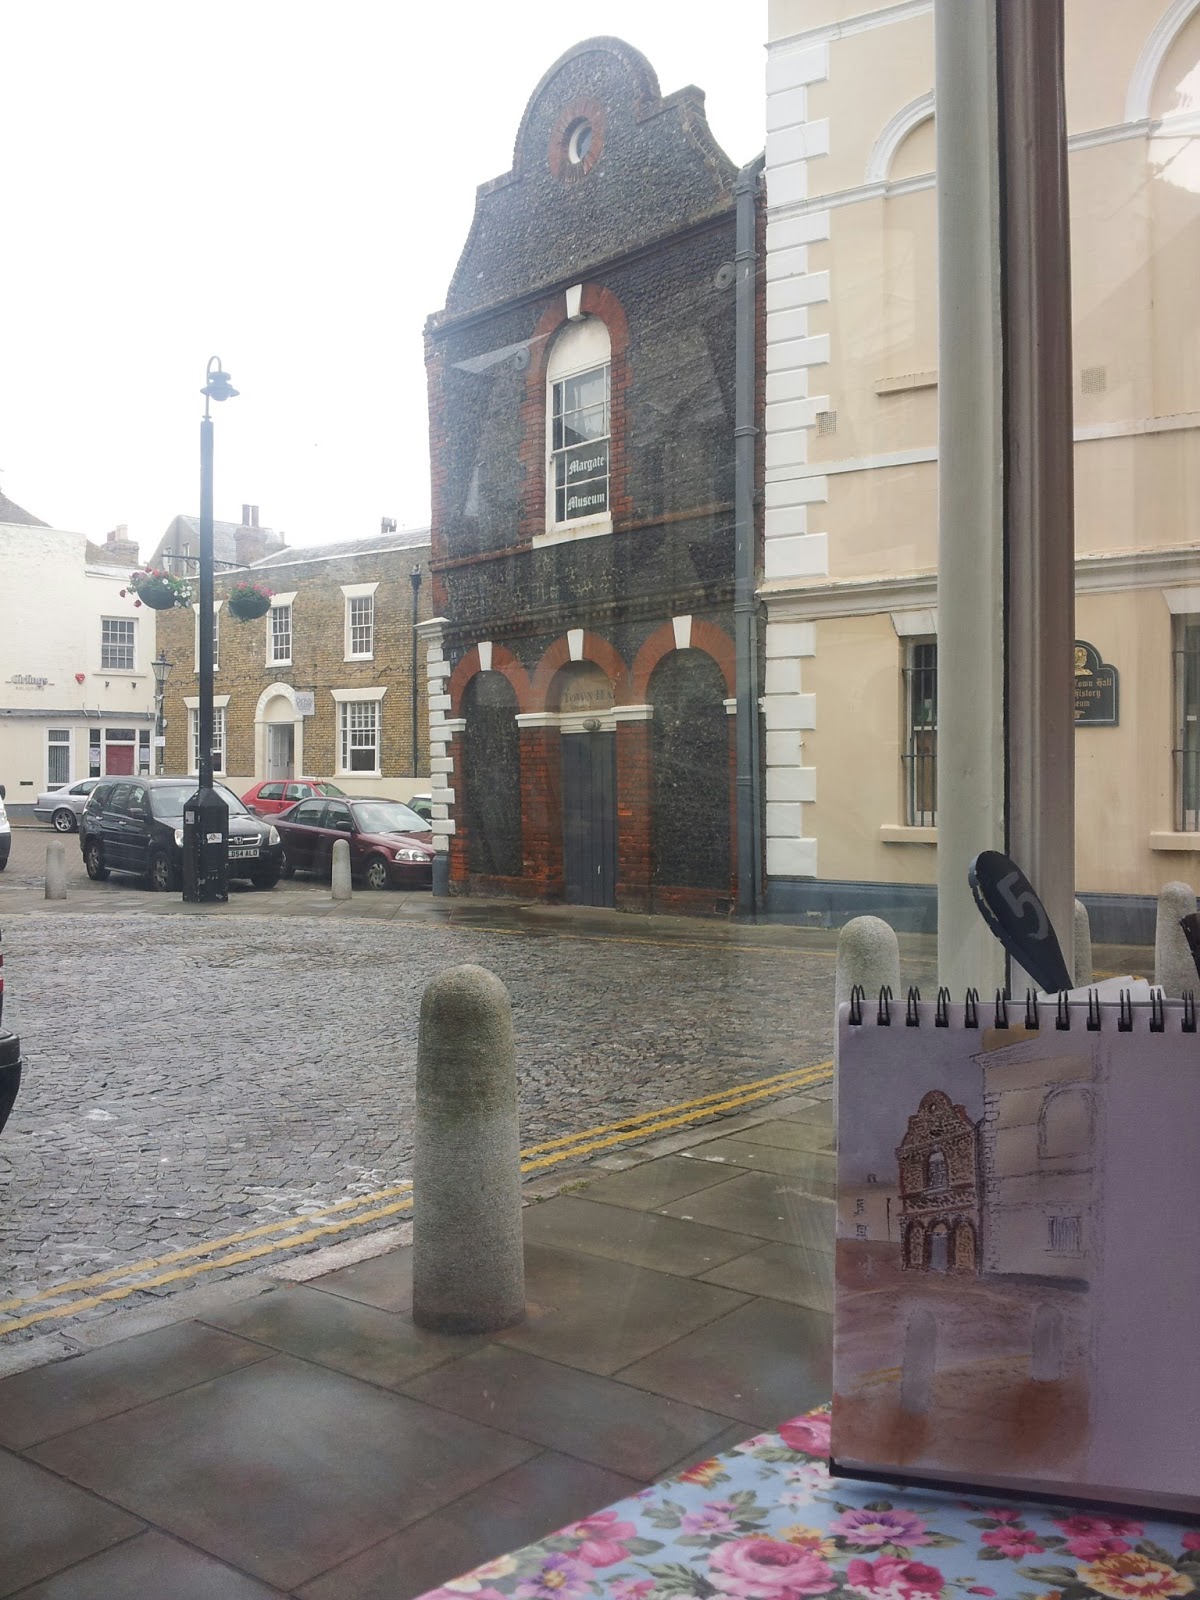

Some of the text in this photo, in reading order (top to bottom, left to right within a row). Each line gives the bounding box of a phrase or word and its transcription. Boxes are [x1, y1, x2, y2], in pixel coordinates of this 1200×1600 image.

[568, 456, 605, 475] Margate
[567, 493, 605, 511] Museum
[11, 674, 48, 688] Girlings
[997, 871, 1049, 940] 5
